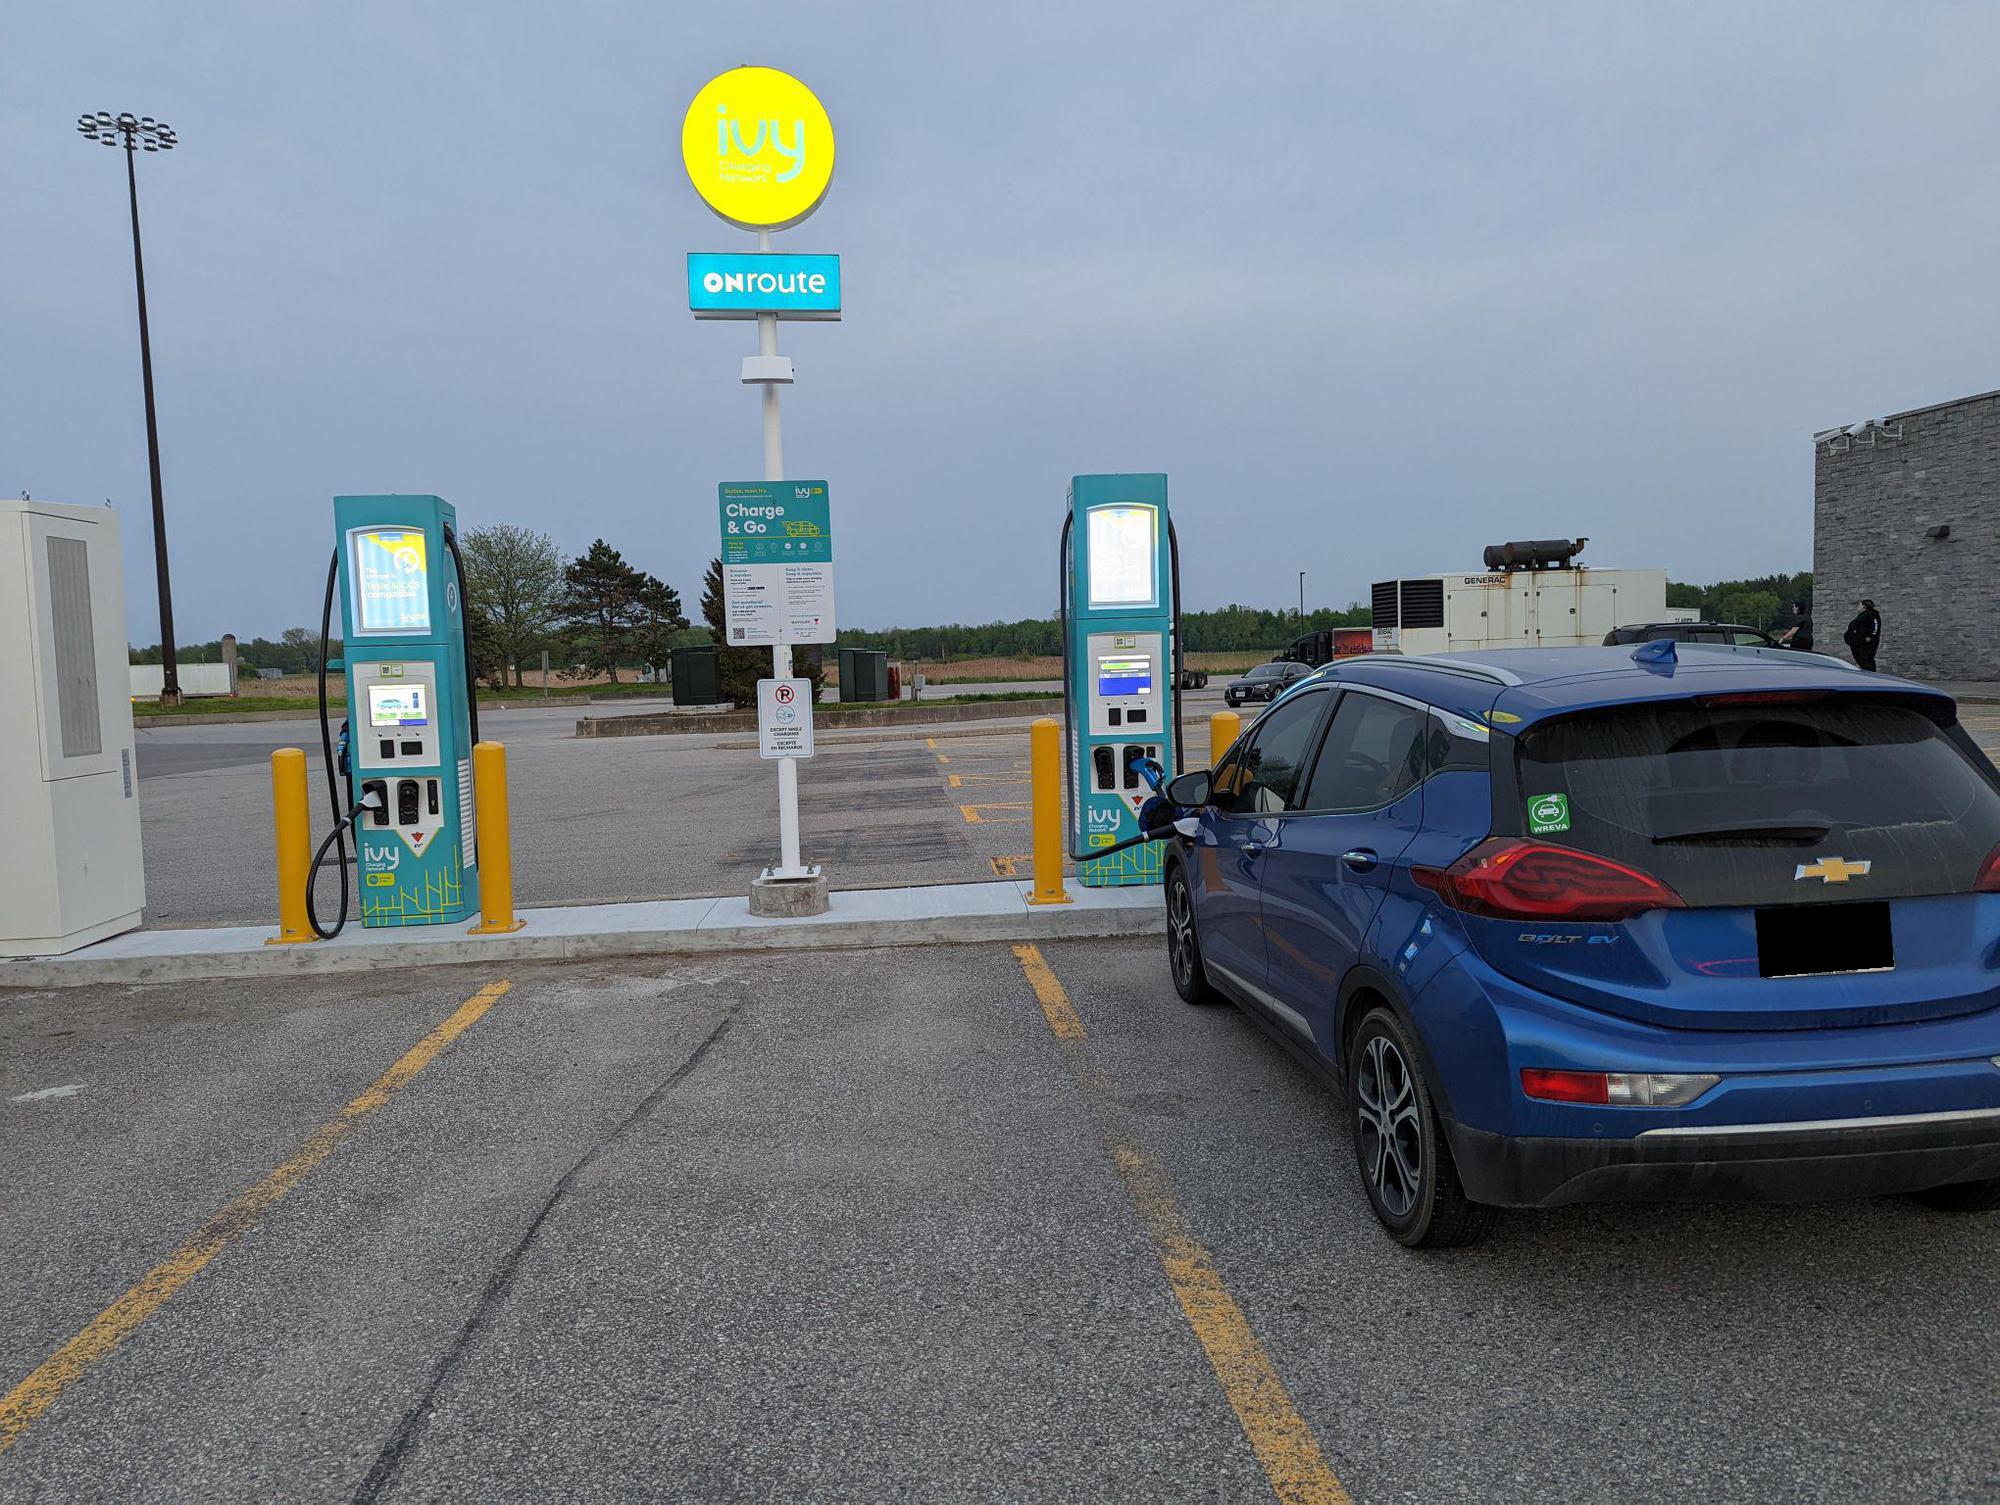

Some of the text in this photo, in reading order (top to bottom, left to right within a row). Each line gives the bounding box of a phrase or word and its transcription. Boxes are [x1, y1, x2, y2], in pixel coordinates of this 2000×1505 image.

[717, 104, 806, 183] ivy
[703, 270, 827, 294] ONroute
[795, 485, 810, 499] ivy
[725, 503, 785, 520] Charge
[727, 520, 767, 534] & Go
[1464, 576, 1506, 585] GENERAC
[1088, 805, 1121, 832] ivy
[1534, 823, 1569, 833] WREVA
[364, 842, 400, 871] ivy
[1517, 934, 1620, 945] BOLT EV
